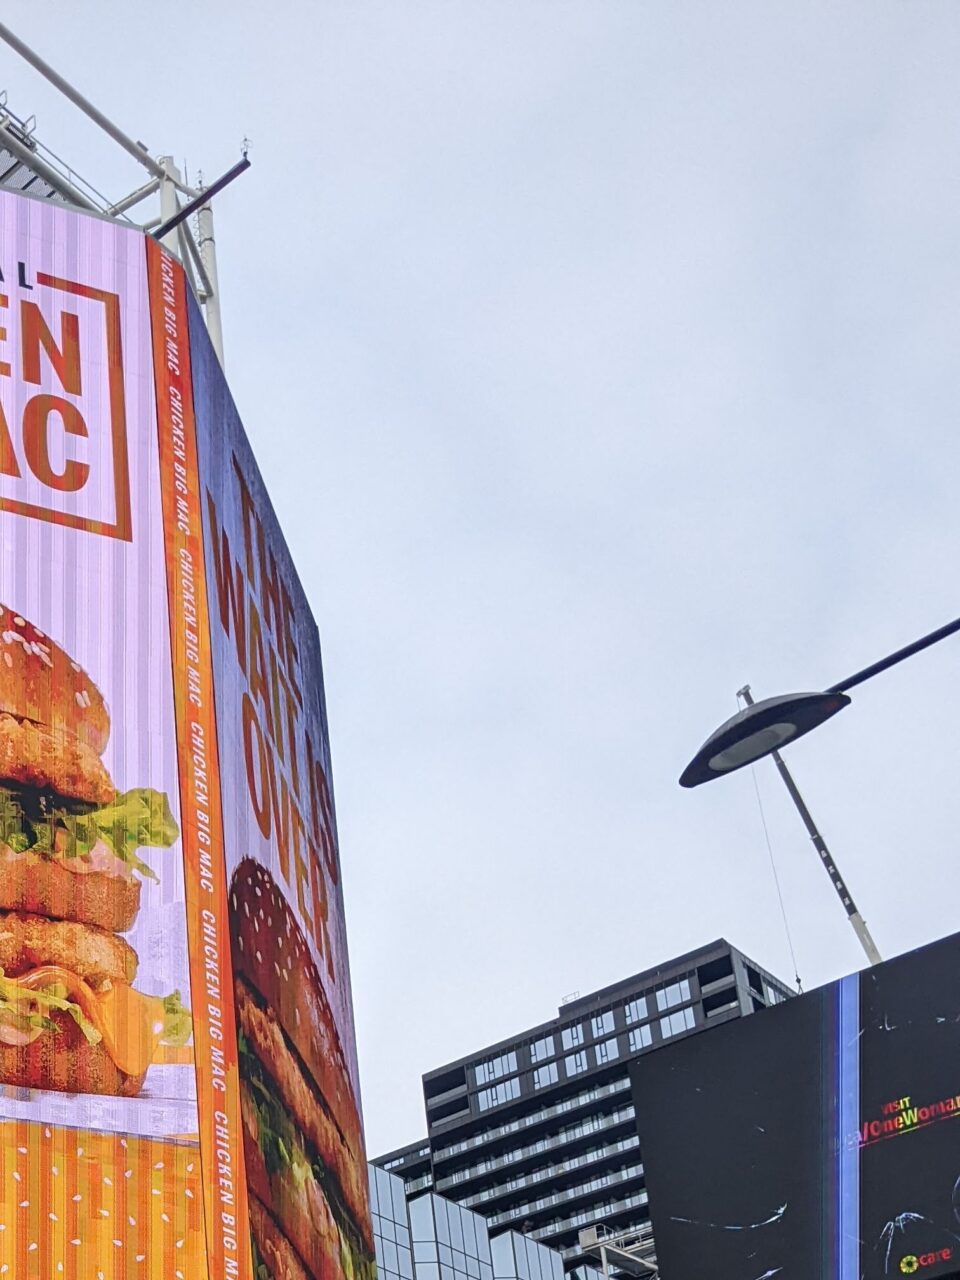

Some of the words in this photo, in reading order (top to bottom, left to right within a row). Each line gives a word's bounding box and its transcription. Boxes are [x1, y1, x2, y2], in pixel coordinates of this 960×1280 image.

[164, 307, 177, 338] BIG
[166, 338, 180, 375] MAC
[169, 385, 186, 460] CHICKEN
[174, 461, 189, 496] BIG
[176, 497, 191, 535] MAC
[180, 548, 196, 625] CHICKEN
[185, 628, 199, 662] BIG
[187, 665, 202, 708] MAC
[191, 721, 209, 806] CHICKEN
[196, 808, 210, 845] BIG
[198, 848, 213, 893] MAC
[201, 909, 221, 1000] CHICKEN
[207, 1003, 223, 1041] BIG
[210, 1045, 226, 1092] MAC
[214, 1110, 233, 1205] CHICKEN
[221, 1212, 237, 1251] BIG
[919, 1248, 952, 1266] care
